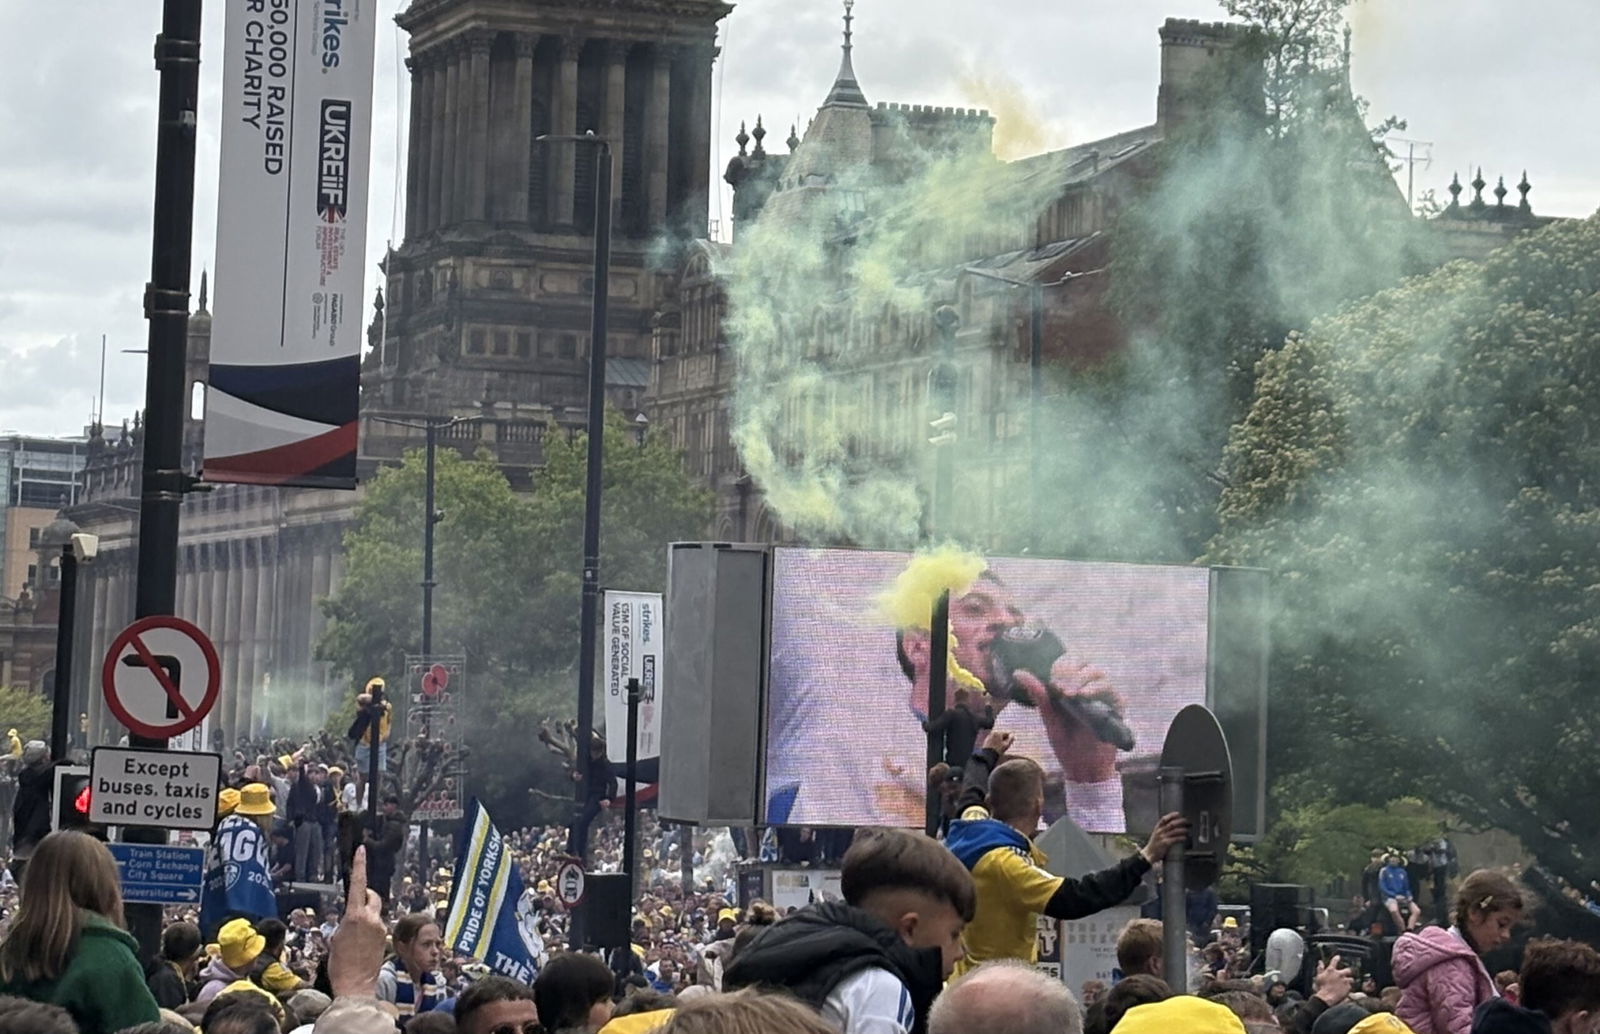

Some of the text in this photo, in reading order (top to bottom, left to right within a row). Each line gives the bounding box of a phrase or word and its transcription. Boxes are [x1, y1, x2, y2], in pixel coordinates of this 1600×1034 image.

[242, 20, 264, 130] CHARITY
[265, 86, 285, 175] RAISED
[621, 625, 630, 640] OF
[610, 602, 621, 696] VALUE GENERATED
[620, 641, 630, 679] SOCIAL
[124, 758, 189, 779] Except
[165, 781, 210, 799] taxis
[102, 800, 203, 819] and cycles
[130, 848, 191, 860] Train Station
[128, 859, 200, 873] Corn Exchange
[128, 869, 184, 881] City Square
[459, 908, 483, 952] PRIDE
[474, 887, 487, 907] OF
